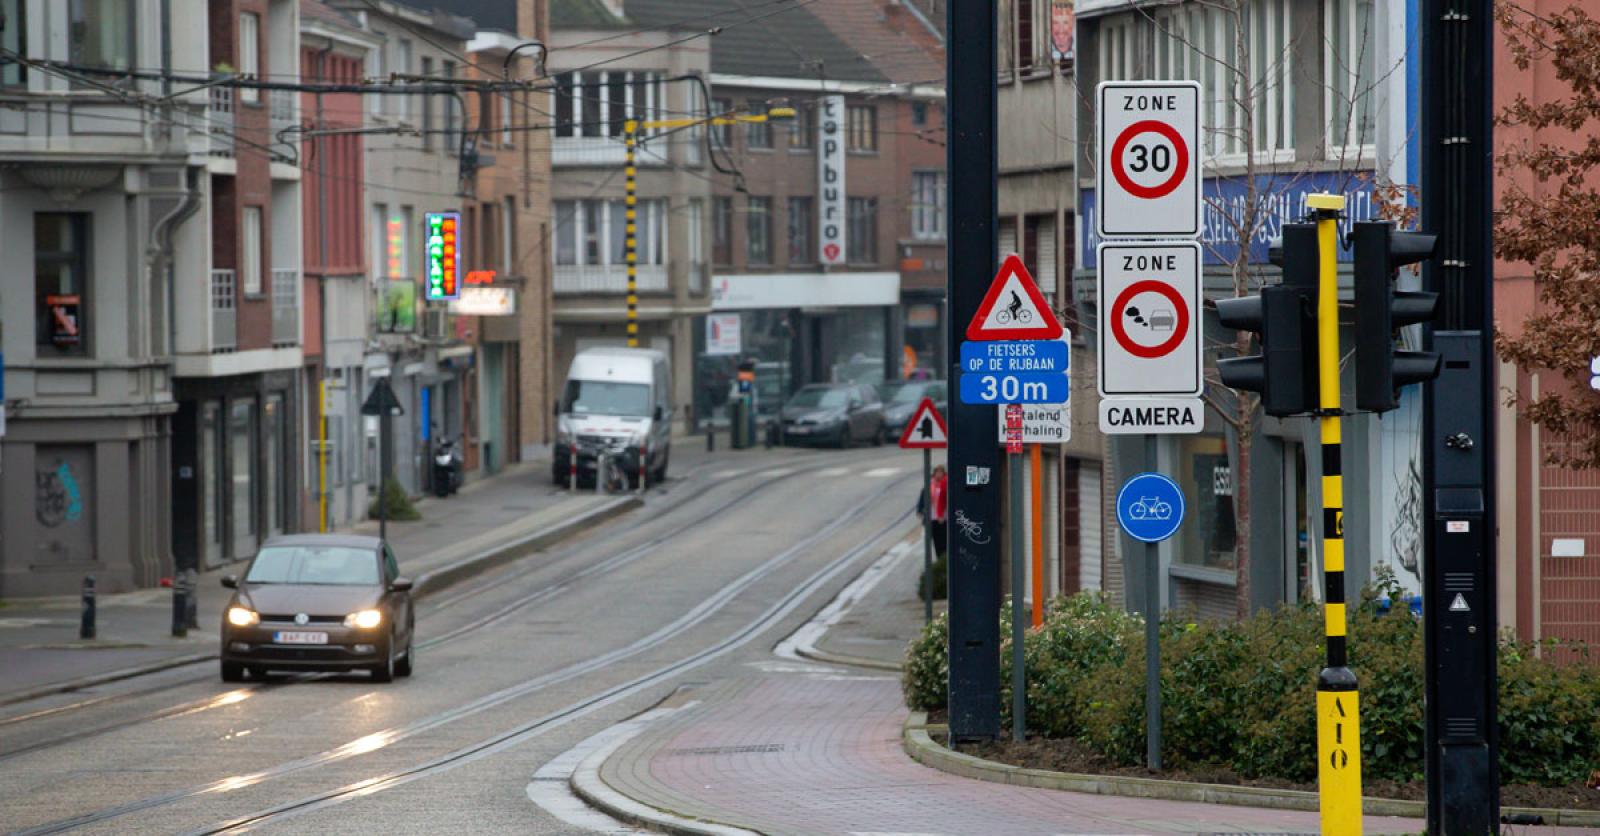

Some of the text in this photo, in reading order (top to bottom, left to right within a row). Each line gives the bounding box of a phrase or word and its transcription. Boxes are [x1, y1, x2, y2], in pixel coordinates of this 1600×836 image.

[1123, 95, 1177, 111] ZONE
[1128, 144, 1171, 173] 30
[1123, 255, 1177, 271] ZONE
[987, 344, 1036, 357] FIETSERS
[969, 357, 1055, 371] OP DE RIJBAAN
[980, 375, 1048, 401] 30m
[1107, 407, 1195, 427] CAMERA
